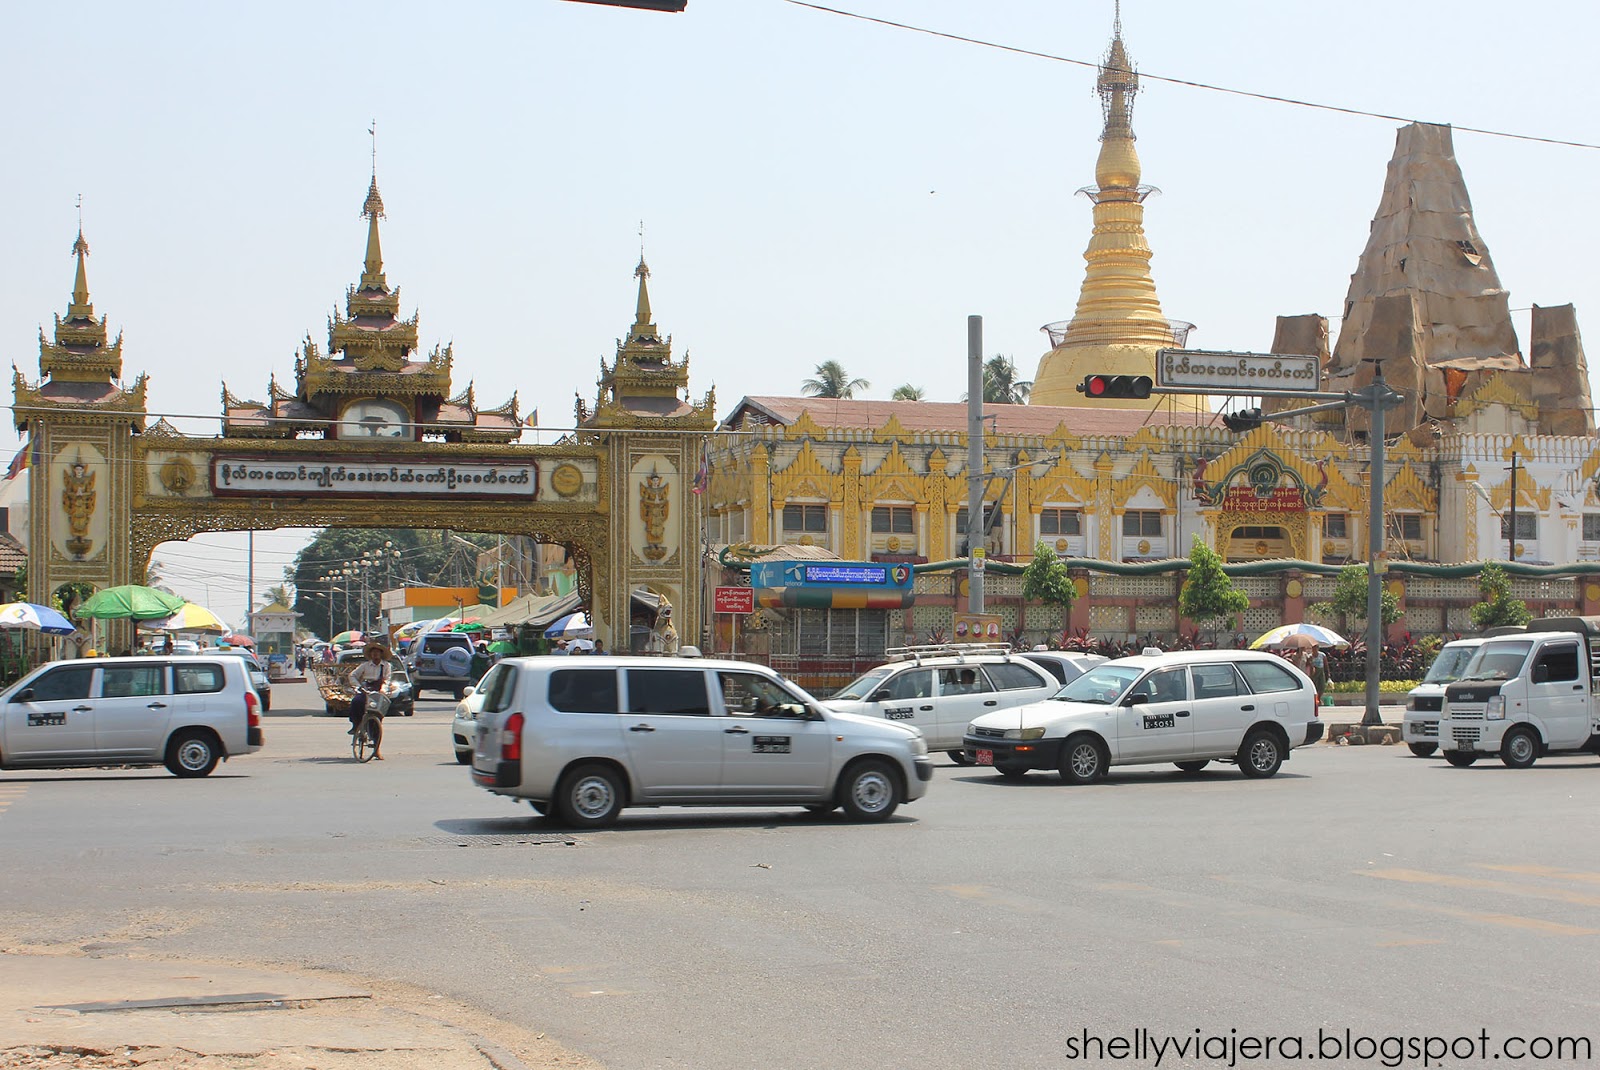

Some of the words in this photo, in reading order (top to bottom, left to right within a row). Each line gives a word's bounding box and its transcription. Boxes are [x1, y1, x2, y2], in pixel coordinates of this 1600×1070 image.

[1165, 355, 1314, 382] ဗိုလ်တထောင်စေတီတော်
[1145, 720, 1173, 729] E-5052
